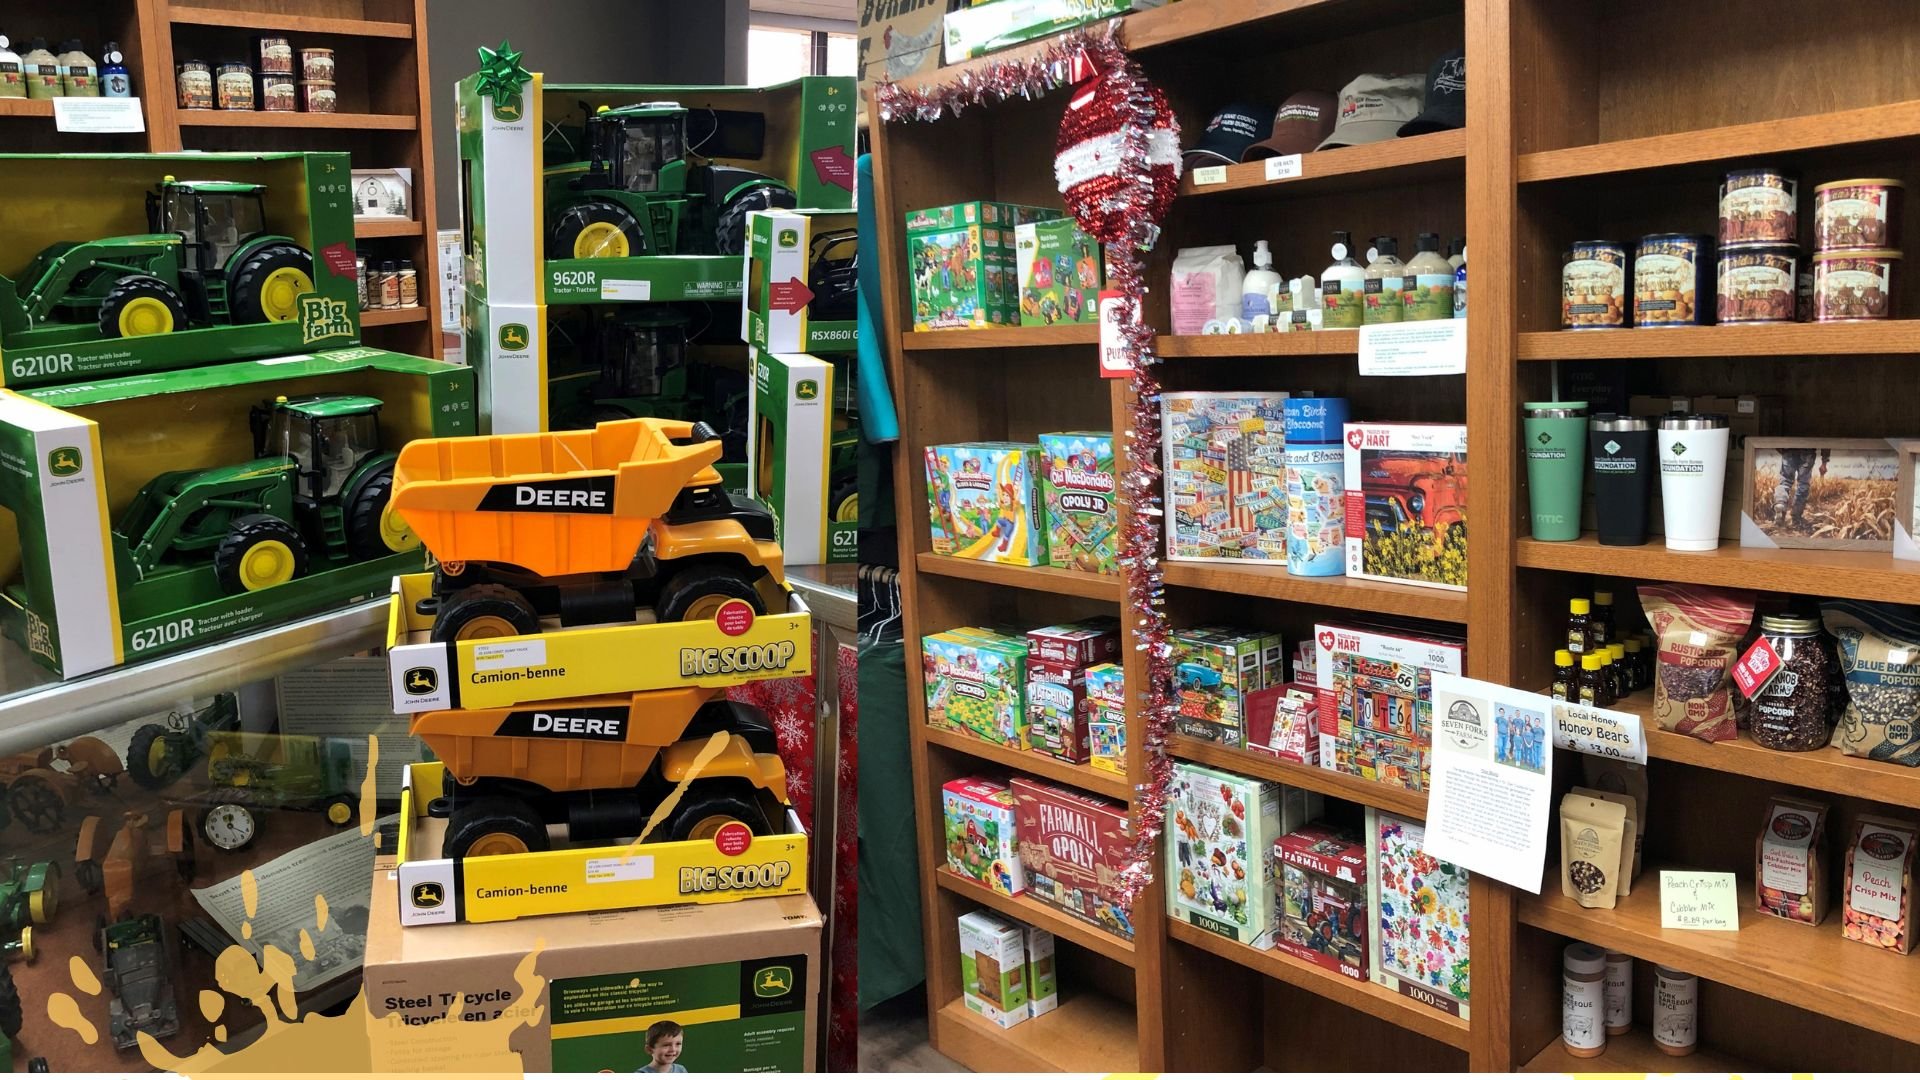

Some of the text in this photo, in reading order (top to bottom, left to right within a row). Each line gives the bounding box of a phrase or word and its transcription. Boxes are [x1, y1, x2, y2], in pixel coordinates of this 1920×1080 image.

[828, 87, 838, 95] 8+
[326, 164, 336, 173] 3+
[553, 271, 596, 285] 9620R
[306, 301, 345, 324] Big
[305, 322, 351, 341] farm
[812, 331, 851, 341] RSX860i
[12, 354, 74, 378] 6210R
[78, 363, 101, 371] Tracteur
[117, 359, 142, 367] chargeur
[31, 385, 95, 397] 6210R
[450, 382, 459, 391] 3+
[1302, 404, 1327, 417] Birds
[1367, 435, 1390, 447] HART
[1294, 452, 1309, 463] and
[1051, 470, 1064, 484] Old
[516, 486, 606, 507] DEERE
[1063, 496, 1091, 509] OPOLY
[131, 606, 253, 651] 6210R Tractor with loader
[199, 611, 263, 634] Tracteur avec chargeur
[790, 622, 799, 630] 3+
[1338, 638, 1360, 652] HART
[1671, 643, 1704, 657] RUSTIC
[680, 640, 795, 677] BIG SCOOP
[1428, 654, 1444, 663] 1000
[1680, 656, 1724, 667] POPCORN
[1858, 660, 1885, 671] BLUE
[471, 668, 566, 684] Camion-benne
[1397, 673, 1412, 687] 66
[1029, 685, 1071, 709] MATCHING
[1359, 696, 1396, 728] ROUTE
[1759, 705, 1795, 716] POPCORN
[533, 713, 620, 735] DEERE
[1568, 710, 1617, 727] Local Honey
[1225, 729, 1238, 740] 750
[1441, 720, 1488, 737] SEVEN FORKS
[1456, 730, 1473, 739] FARM
[1559, 720, 1630, 744] Honey Bears
[1889, 724, 1908, 732] NON
[1889, 732, 1908, 740] GMO
[1590, 743, 1619, 757] $3.00
[1040, 804, 1103, 856] FARMALL
[1052, 838, 1094, 869] OPOLY
[1764, 854, 1806, 867] Old-Fashioned
[1284, 851, 1362, 873] FARMALL 1000
[1767, 861, 1790, 872] Cobbler
[680, 861, 790, 894] BIG SCOOP
[1665, 876, 1729, 890] Peach Crisp Mix
[1863, 871, 1892, 889] Peach
[476, 883, 568, 899] Camion-benne
[1855, 884, 1897, 902] Crisp Mix
[1671, 901, 1715, 913] Cobbler Mix
[1198, 916, 1219, 932] 1000
[1339, 964, 1360, 978] 1000
[385, 995, 432, 1010] Steel
[1409, 986, 1435, 1005] 1000
[464, 1011, 486, 1022] en
